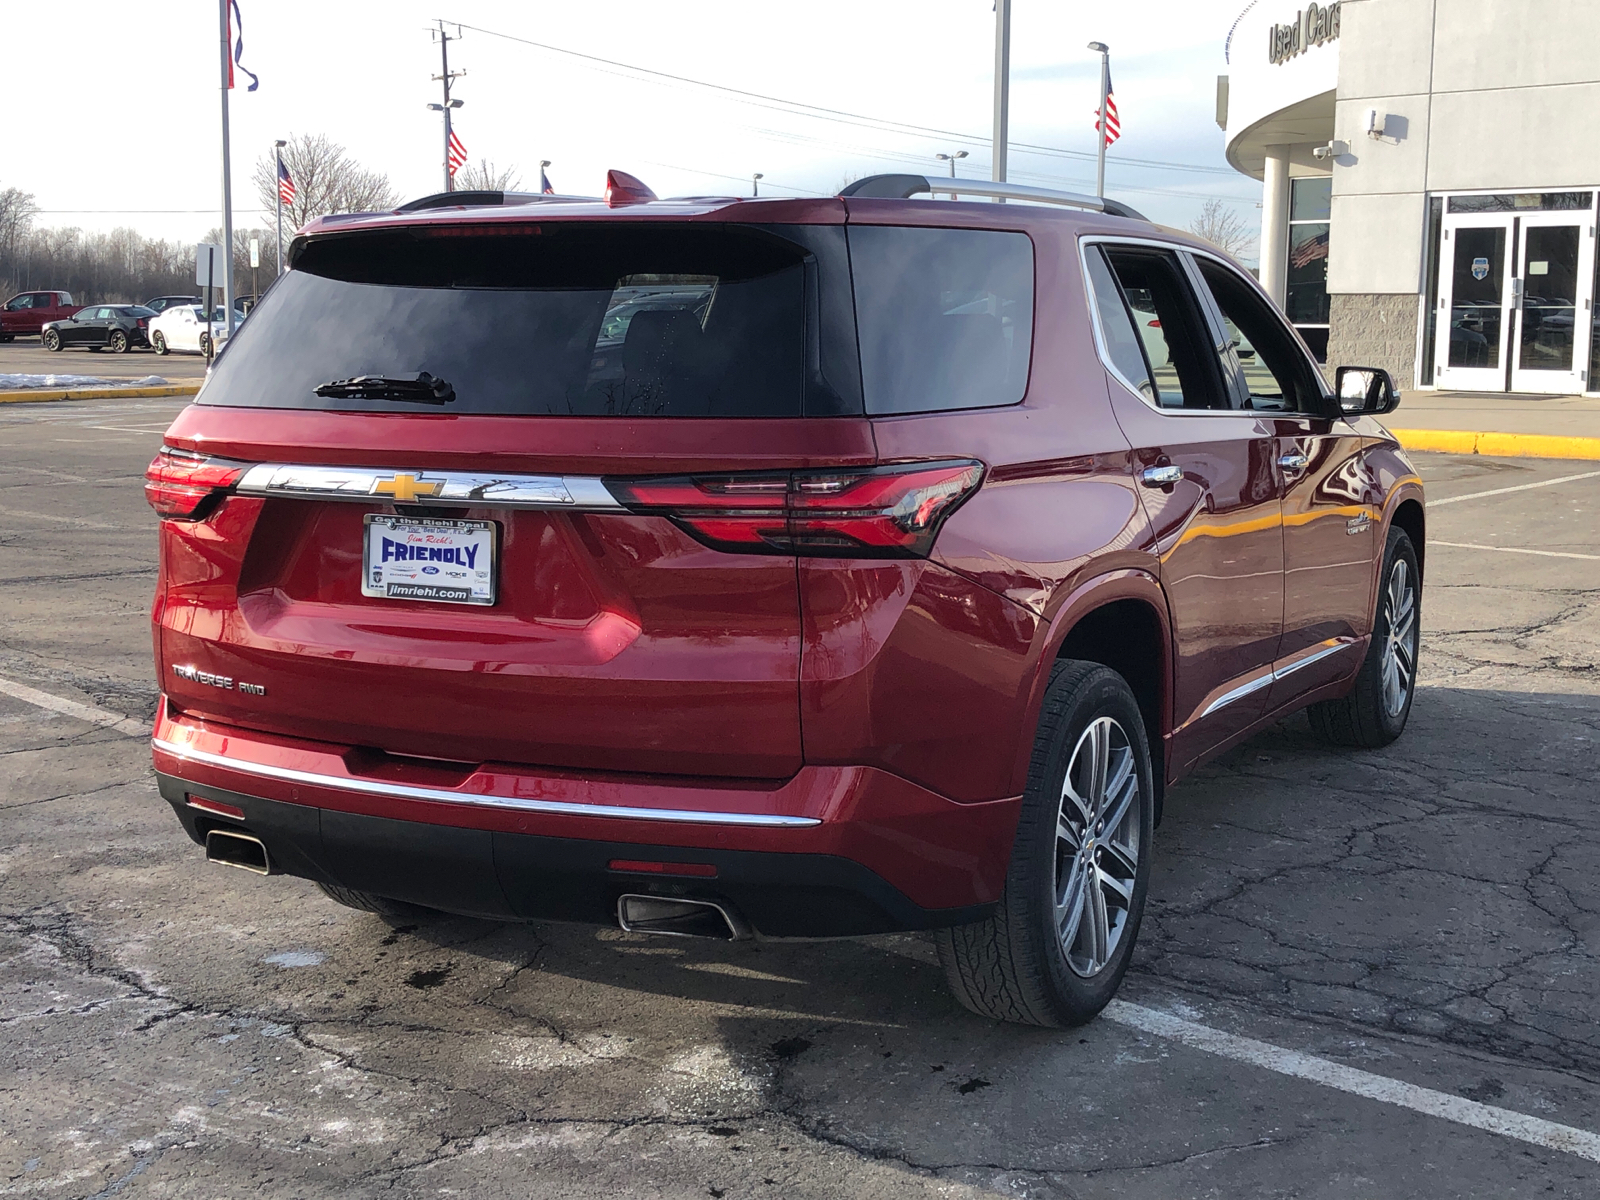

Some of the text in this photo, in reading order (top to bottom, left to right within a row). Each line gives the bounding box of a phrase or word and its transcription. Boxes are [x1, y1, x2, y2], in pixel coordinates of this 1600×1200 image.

[1269, 1, 1341, 64] Used Cars
[399, 516, 419, 525] the
[423, 518, 453, 527] Riehl
[457, 520, 485, 529] Deal
[406, 534, 453, 545] Jim Riehl's
[382, 536, 480, 570] FRIENDLY
[389, 585, 467, 599] jimriehl.com
[172, 664, 265, 695] TRAVERSE AWD
